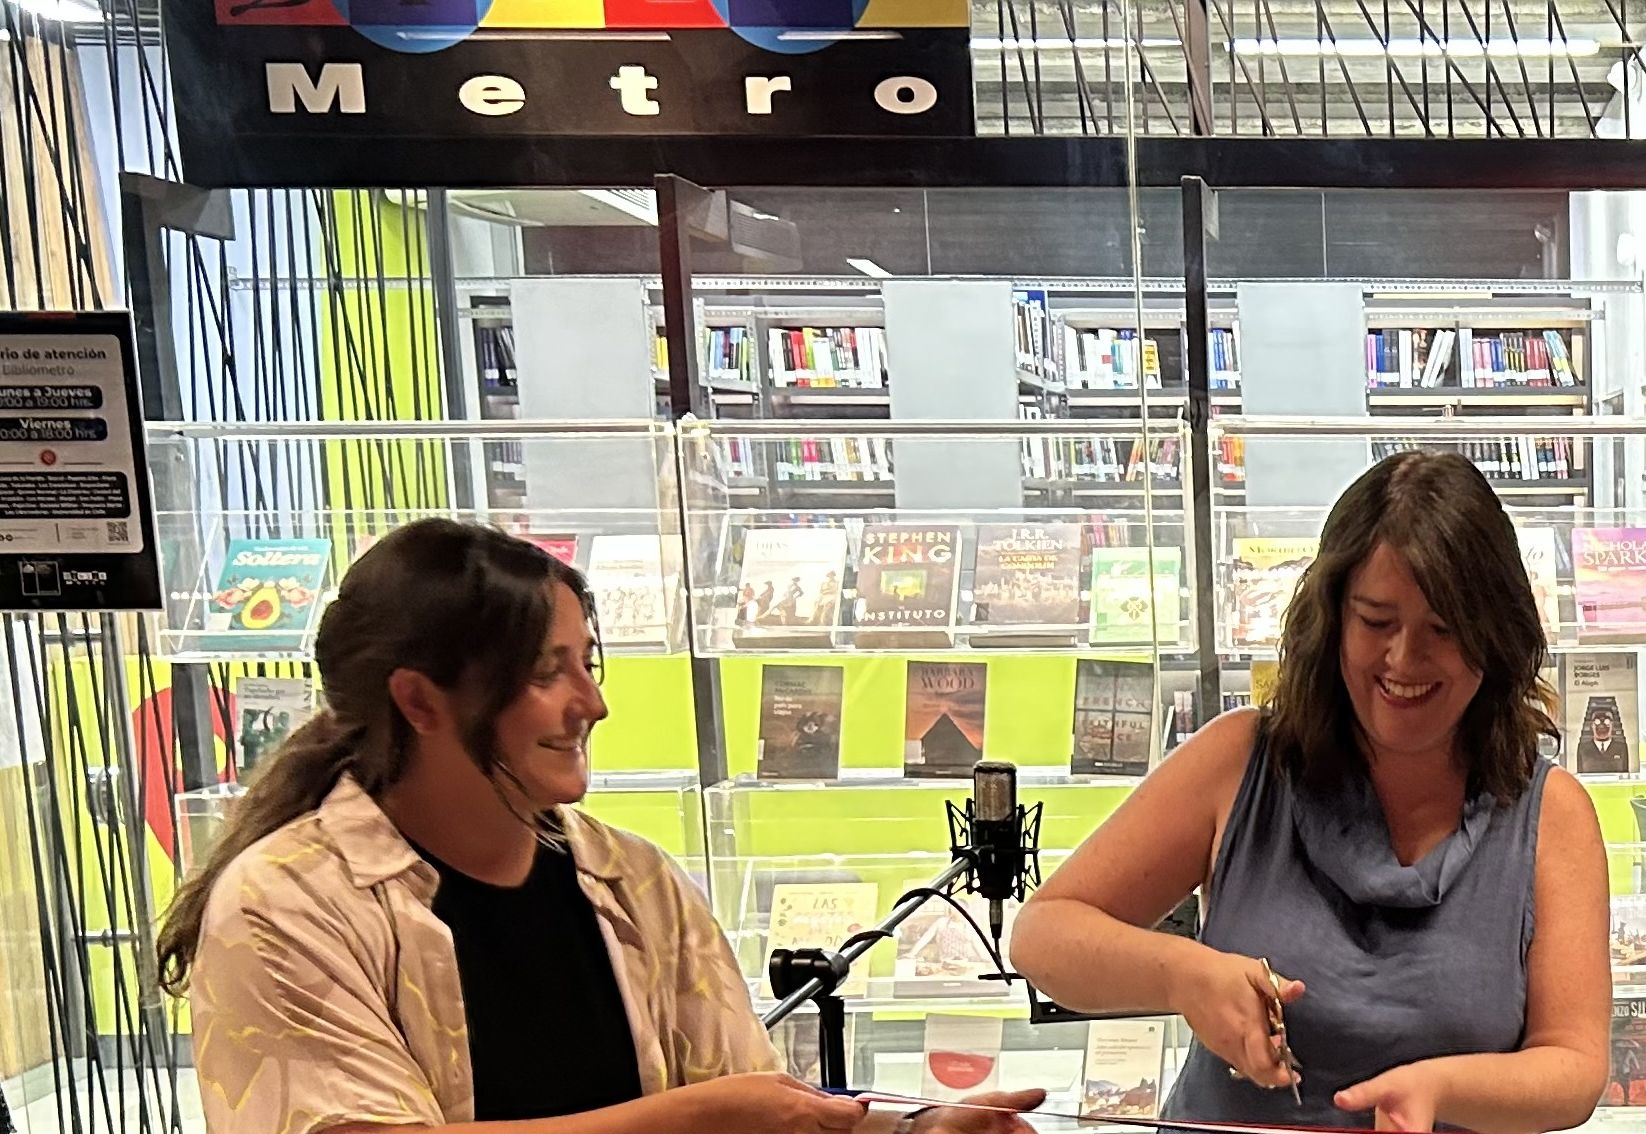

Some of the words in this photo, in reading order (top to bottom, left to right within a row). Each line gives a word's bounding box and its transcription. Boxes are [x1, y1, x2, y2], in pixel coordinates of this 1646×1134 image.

[267, 62, 937, 117] Metro
[23, 347, 40, 359] de
[45, 346, 106, 360] atención
[45, 387, 93, 398] Jueves
[19, 418, 72, 429] Viernes
[865, 531, 951, 545] STEPHEN
[1012, 528, 1049, 540] J.R.R.
[992, 537, 1064, 550] TOLKIEN
[232, 551, 321, 566] Soltera
[863, 545, 952, 565] KING
[861, 608, 947, 622] NSTITUTO
[921, 677, 975, 689] WOOD
